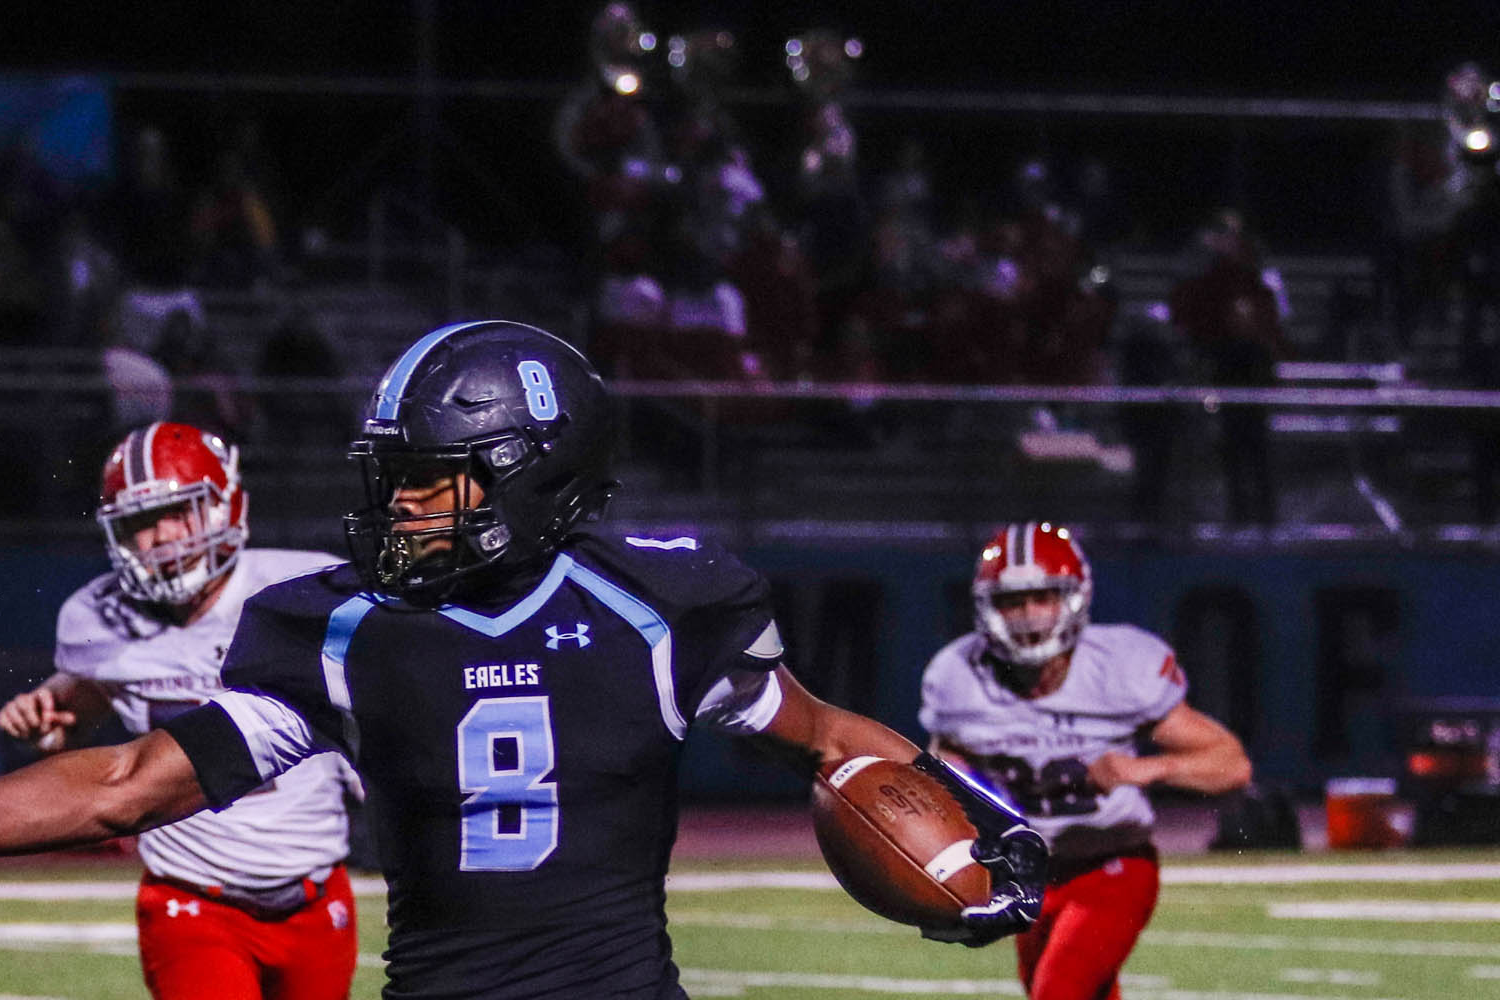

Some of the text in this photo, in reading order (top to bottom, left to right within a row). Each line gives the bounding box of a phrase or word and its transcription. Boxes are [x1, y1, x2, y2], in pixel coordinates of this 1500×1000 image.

[518, 360, 559, 421] 8
[464, 664, 540, 689] EAGLES
[457, 696, 559, 872] 8
